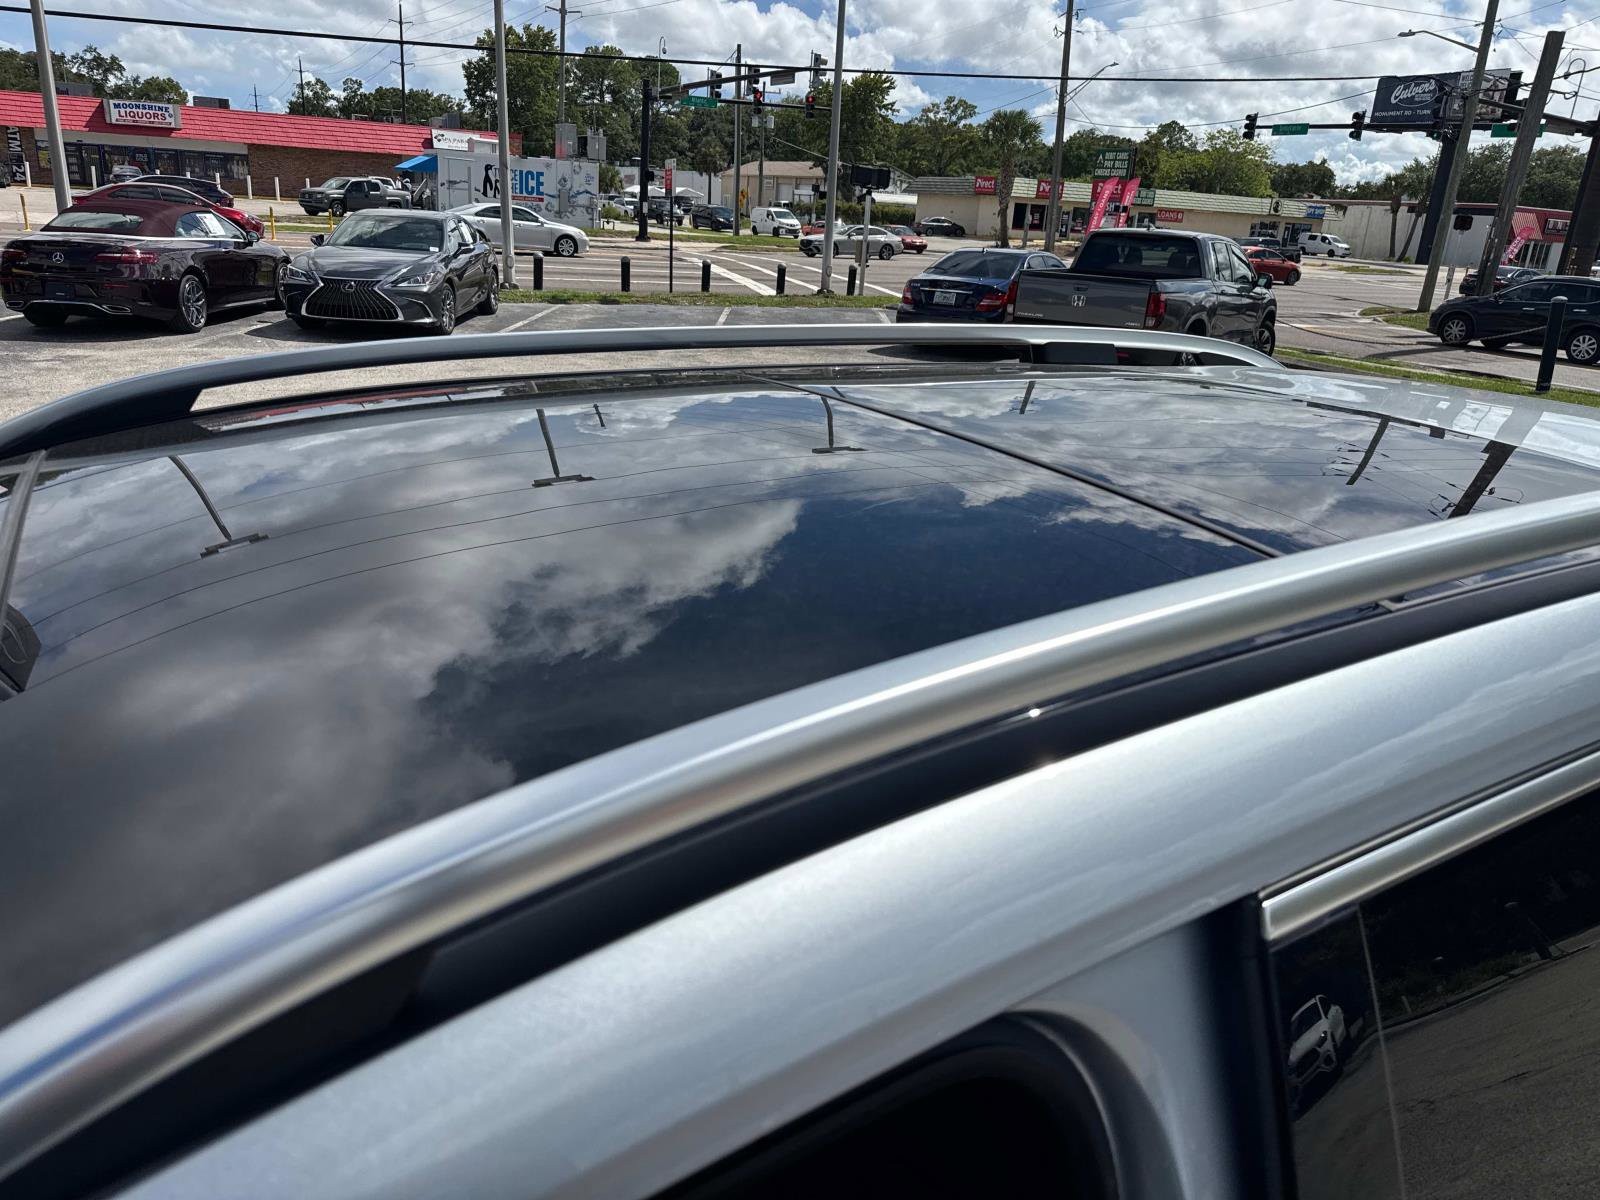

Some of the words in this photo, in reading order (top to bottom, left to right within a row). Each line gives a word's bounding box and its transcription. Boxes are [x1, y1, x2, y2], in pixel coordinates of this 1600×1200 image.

[1391, 79, 1436, 104] Culver's
[113, 103, 170, 113] MOONSHINE
[118, 110, 167, 121] LIQUORS
[7, 126, 22, 152] ATM
[1104, 160, 1114, 168] PAY
[1115, 160, 1128, 168] BILLS
[13, 164, 26, 181] 24
[1095, 168, 1110, 176] CHECKS
[519, 169, 545, 196] ICE
[976, 178, 995, 188] Direct
[1157, 210, 1178, 219] LOANS
